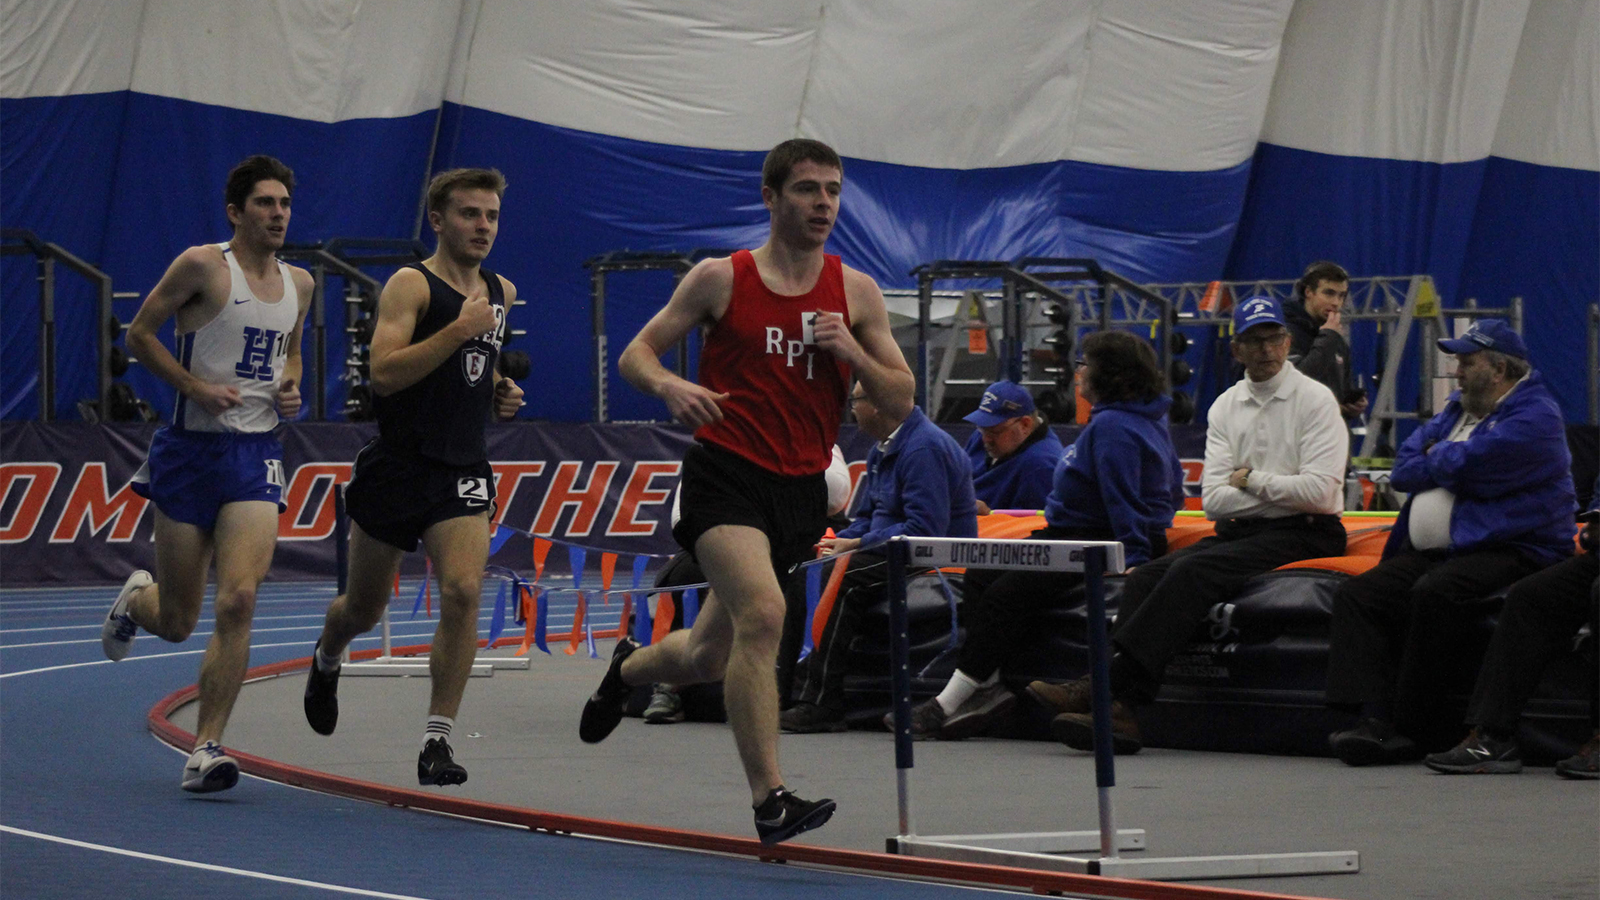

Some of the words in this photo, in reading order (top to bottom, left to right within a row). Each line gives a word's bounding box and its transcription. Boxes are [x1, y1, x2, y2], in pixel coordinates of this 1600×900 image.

[235, 326, 280, 381] H
[470, 355, 480, 376] E
[765, 326, 815, 380] RPI
[0, 462, 155, 543] OM
[489, 461, 683, 537] THE
[461, 478, 483, 498] 2
[950, 542, 987, 564] UTICA
[990, 543, 1051, 566] PIONEERS
